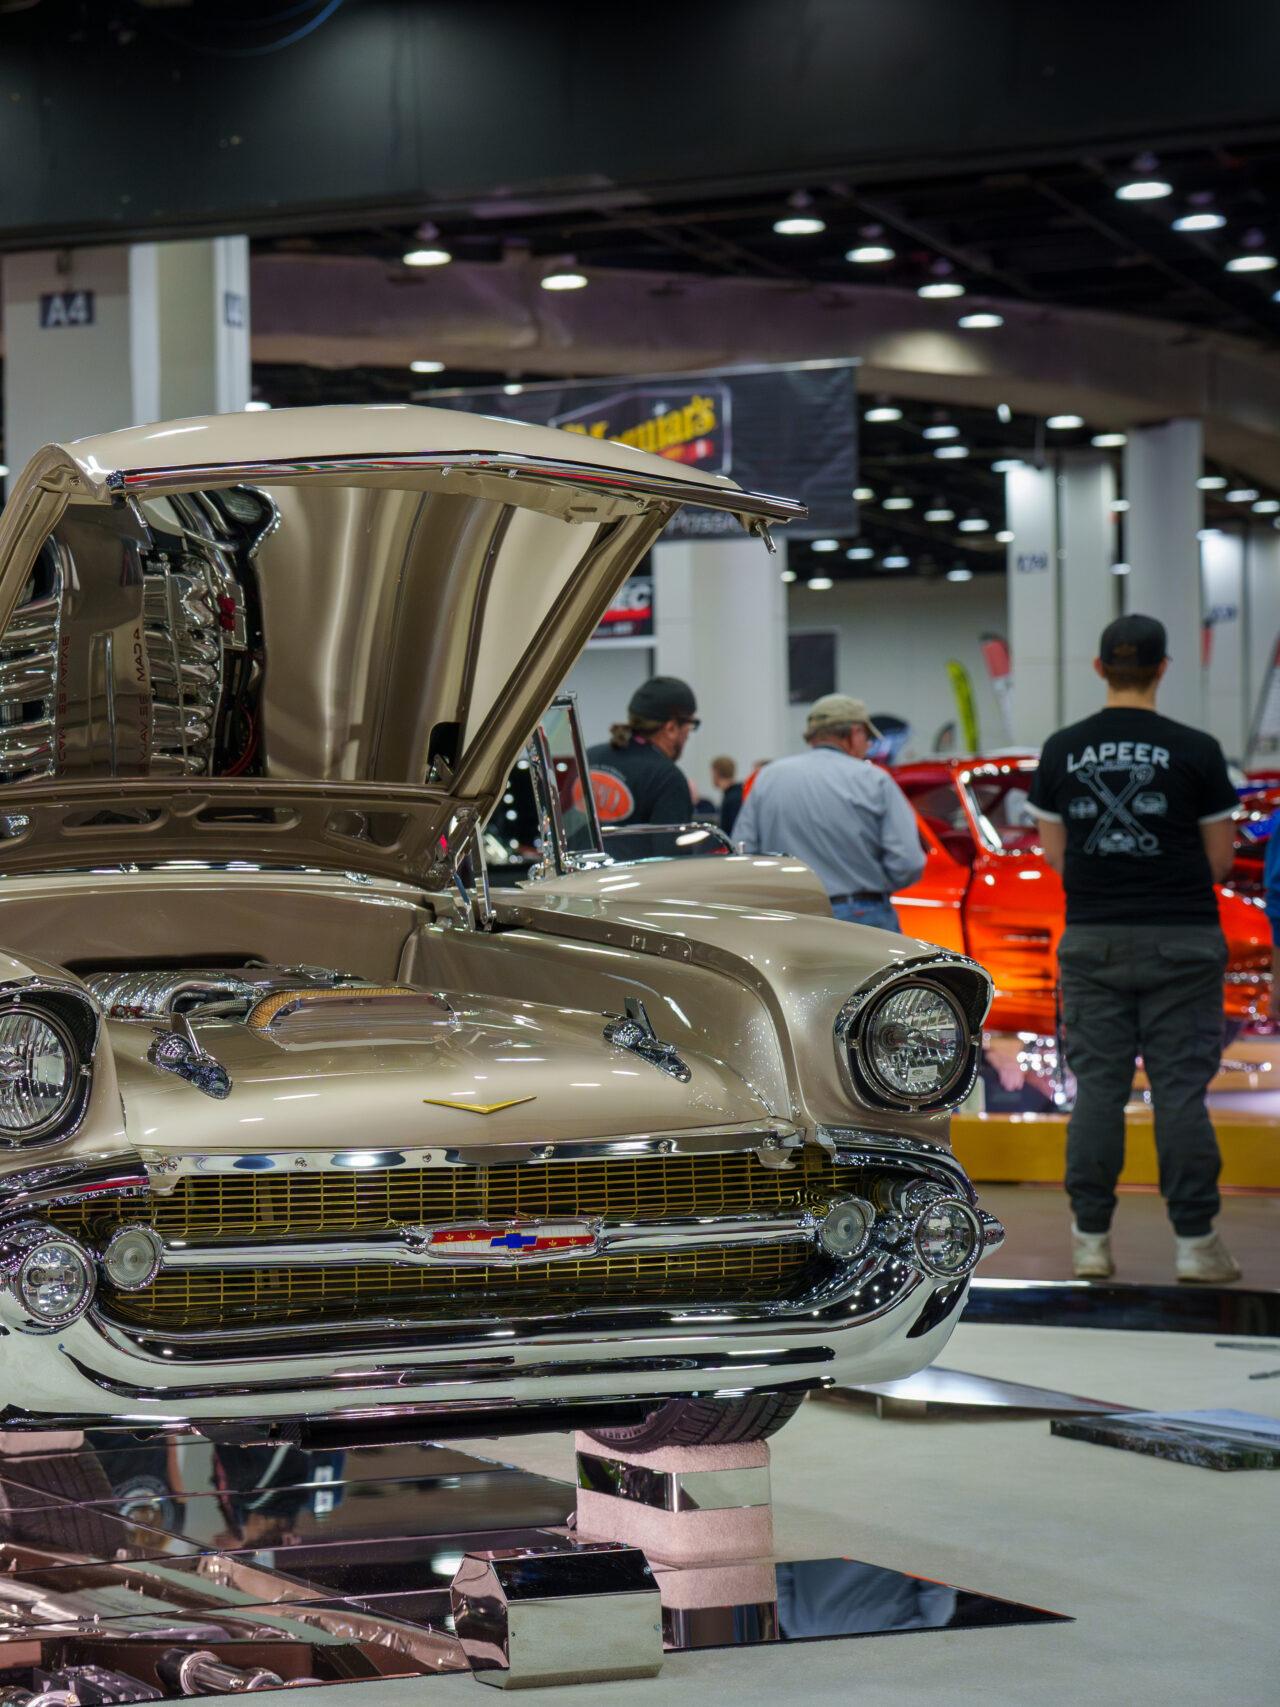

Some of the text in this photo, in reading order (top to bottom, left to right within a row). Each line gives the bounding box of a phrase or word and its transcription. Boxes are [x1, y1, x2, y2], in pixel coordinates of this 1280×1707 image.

[48, 295, 89, 326] A4
[562, 395, 716, 454] guiar's
[1066, 742, 1170, 773] LAPEER
